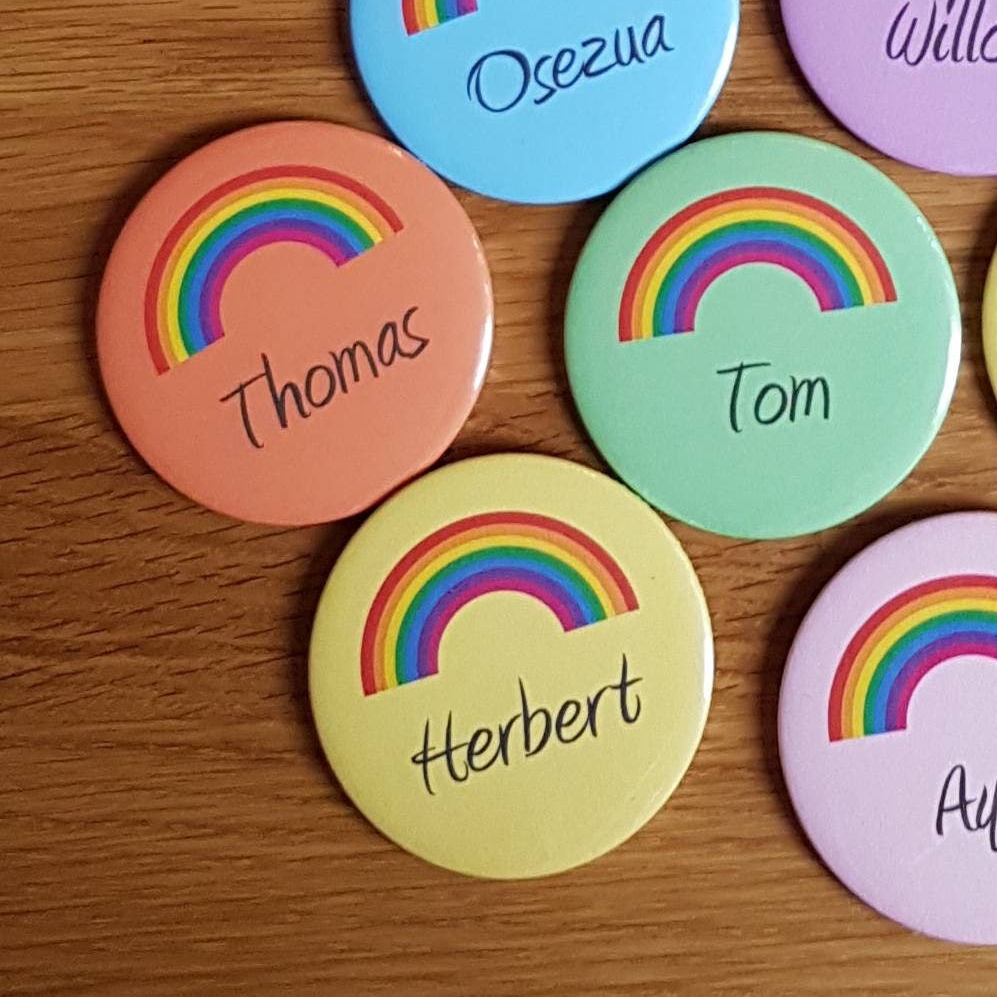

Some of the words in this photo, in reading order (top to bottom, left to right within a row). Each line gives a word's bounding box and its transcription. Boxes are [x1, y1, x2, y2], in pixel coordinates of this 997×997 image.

[466, 14, 674, 113] Osezua
[218, 305, 430, 449] Thomas
[716, 362, 830, 433] Tom
[410, 652, 643, 796] Herbert
